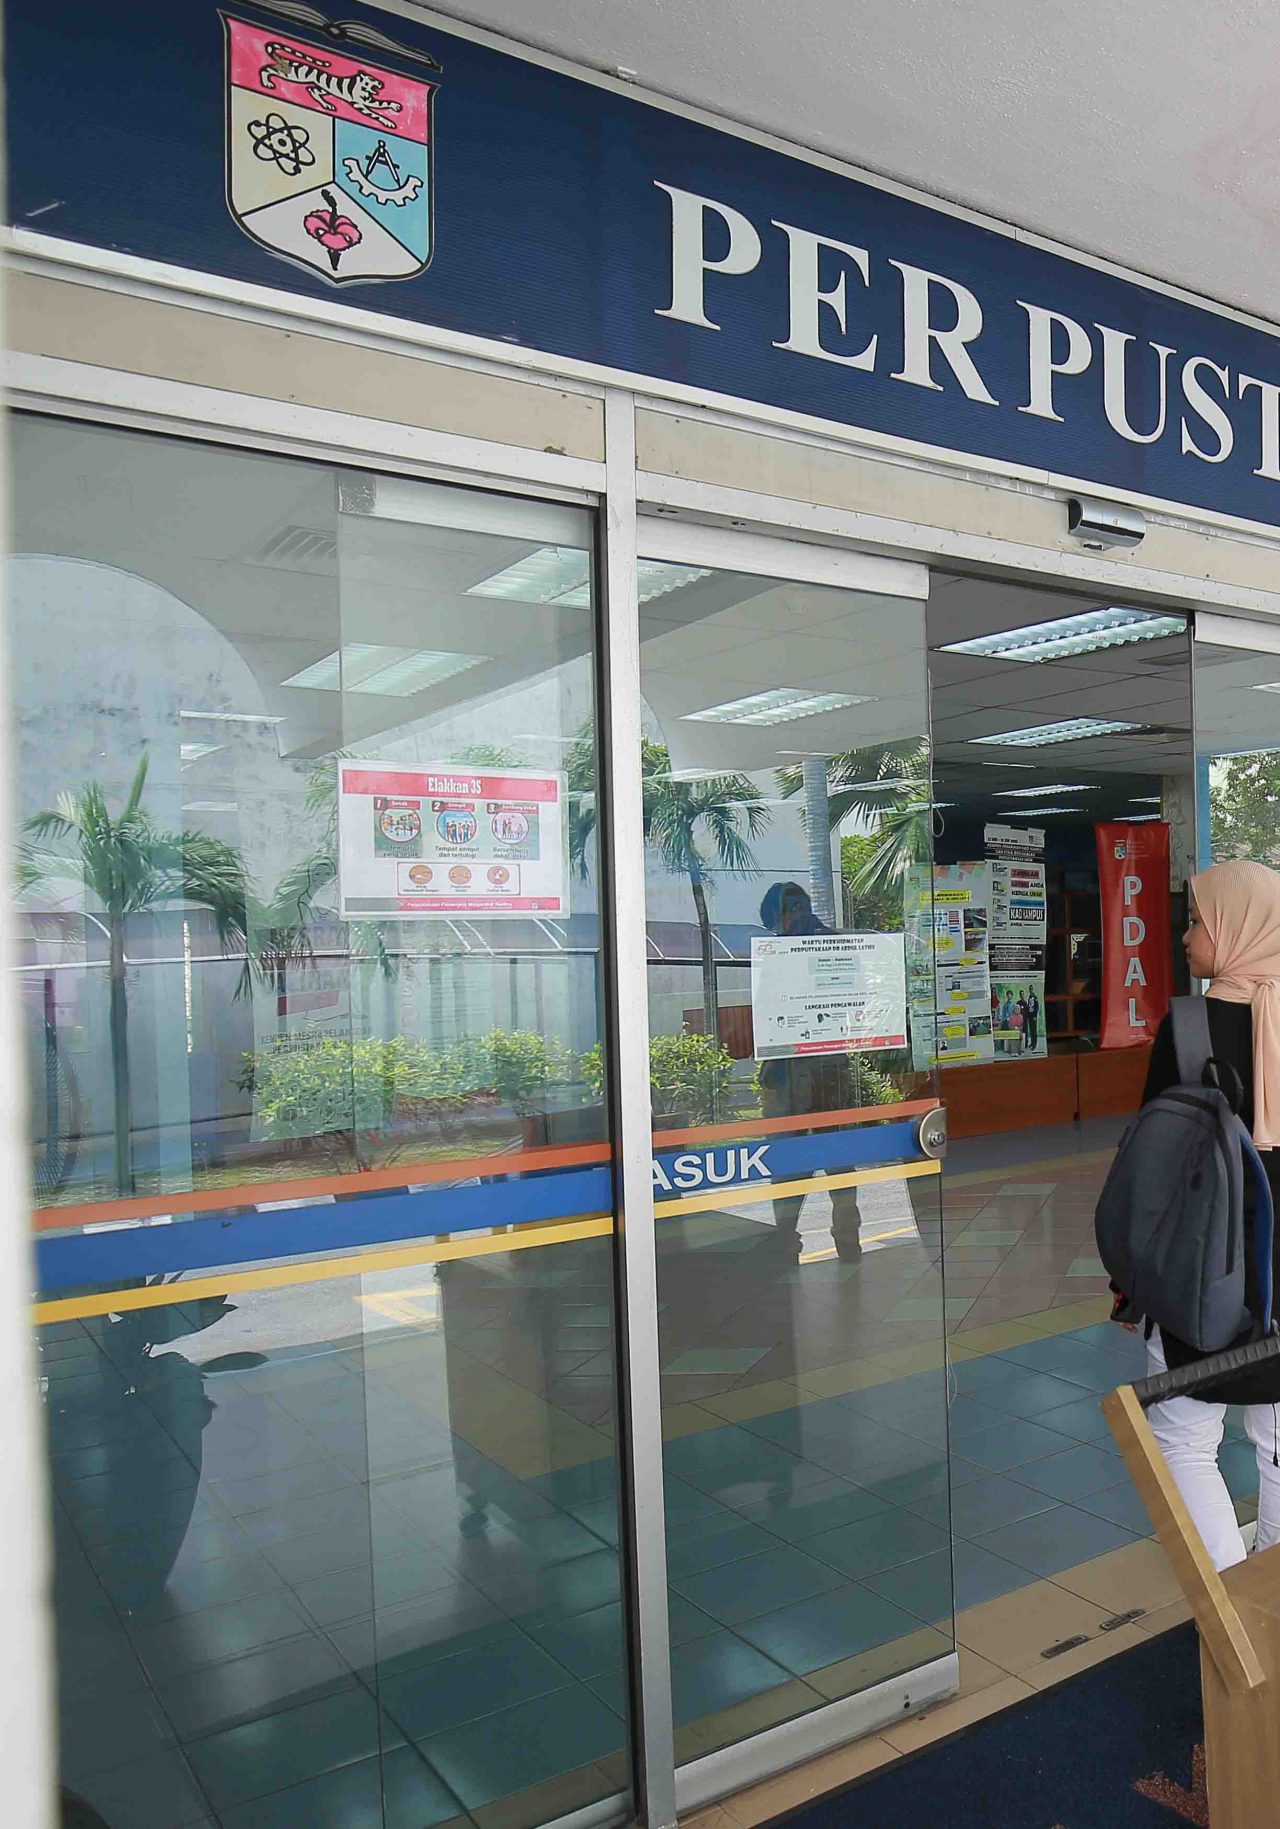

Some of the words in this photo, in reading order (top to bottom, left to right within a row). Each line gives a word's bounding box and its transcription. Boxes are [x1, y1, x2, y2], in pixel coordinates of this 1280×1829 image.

[428, 777, 469, 794] Elakkan
[470, 778, 482, 795] 3S
[433, 801, 441, 810] 2
[488, 804, 495, 813] 3
[1122, 875, 1147, 1027] PDAL
